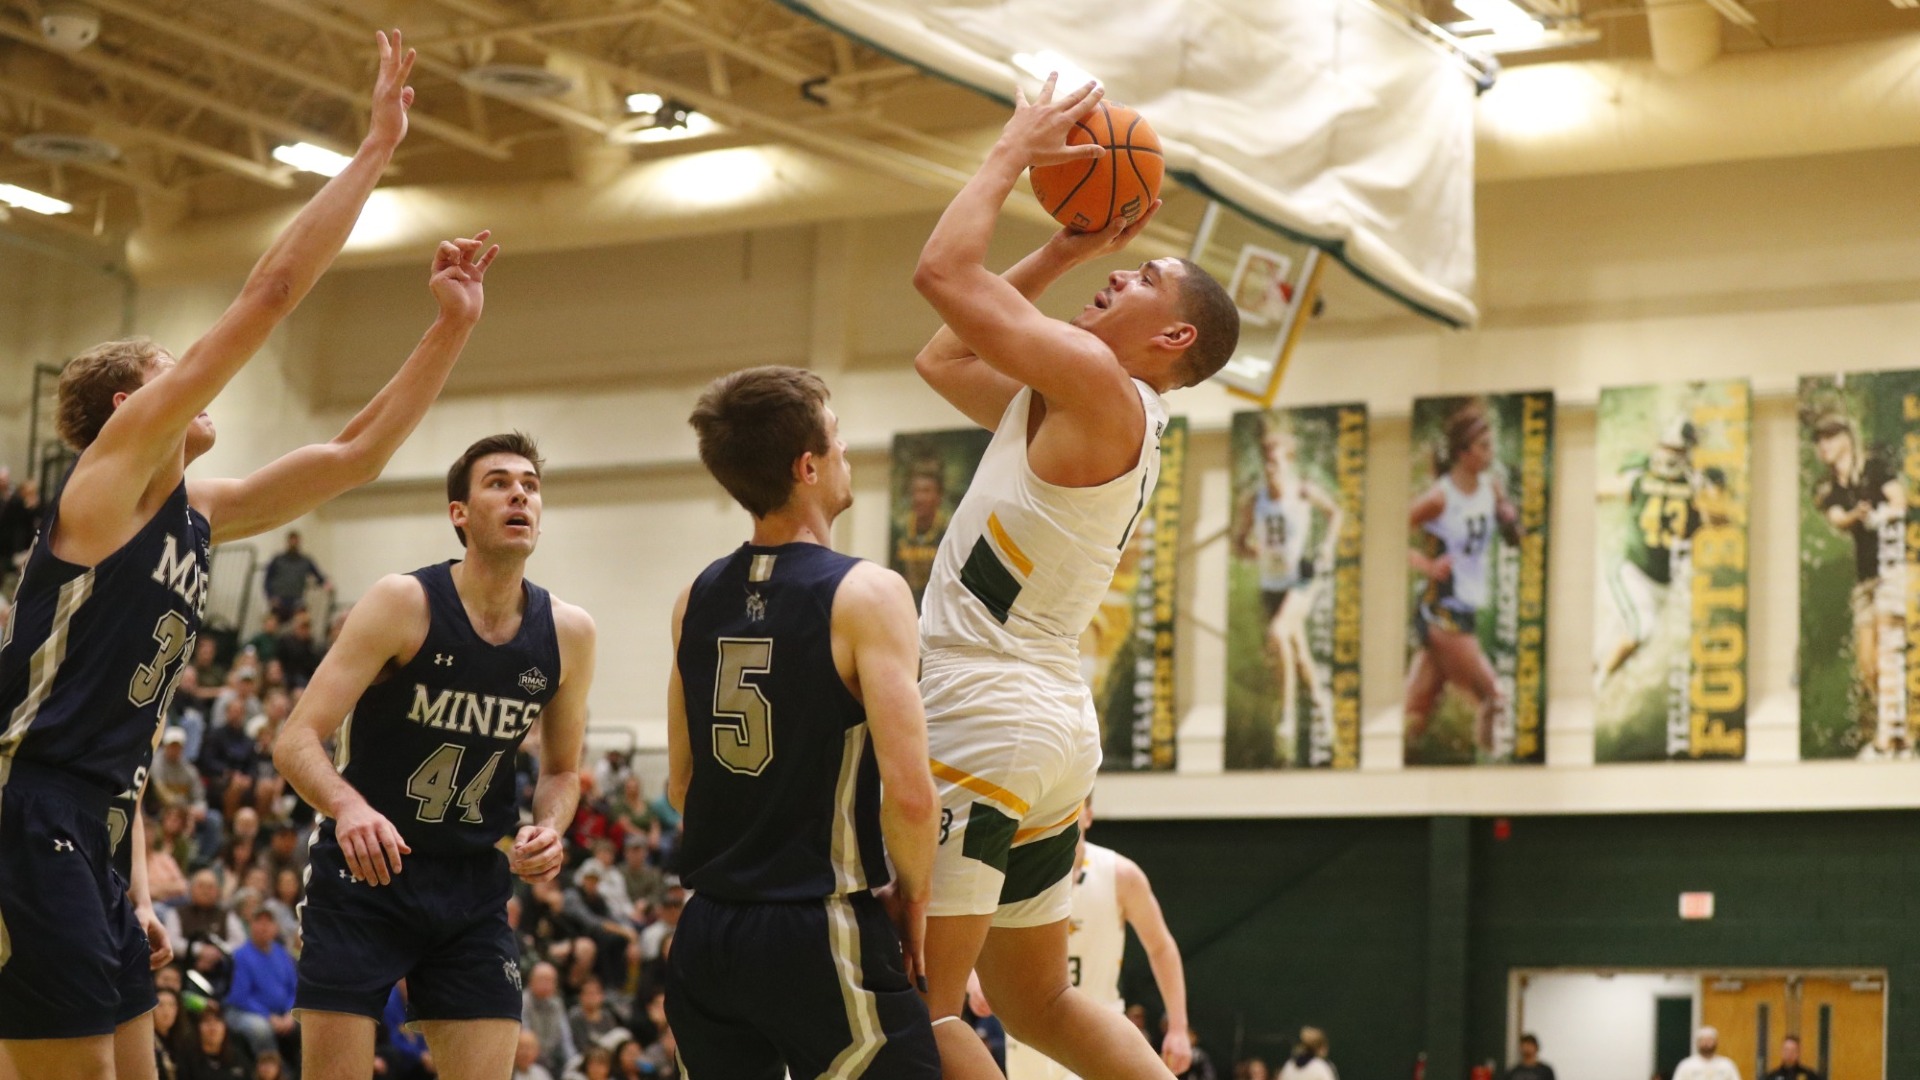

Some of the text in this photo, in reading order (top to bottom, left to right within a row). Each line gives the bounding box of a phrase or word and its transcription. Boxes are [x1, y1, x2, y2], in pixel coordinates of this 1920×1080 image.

[1689, 380, 1750, 758] FOOTBALL
[406, 683, 541, 740] MINES
[521, 674, 546, 688] RMAC
[712, 637, 774, 777] 5
[406, 742, 506, 824] 44
